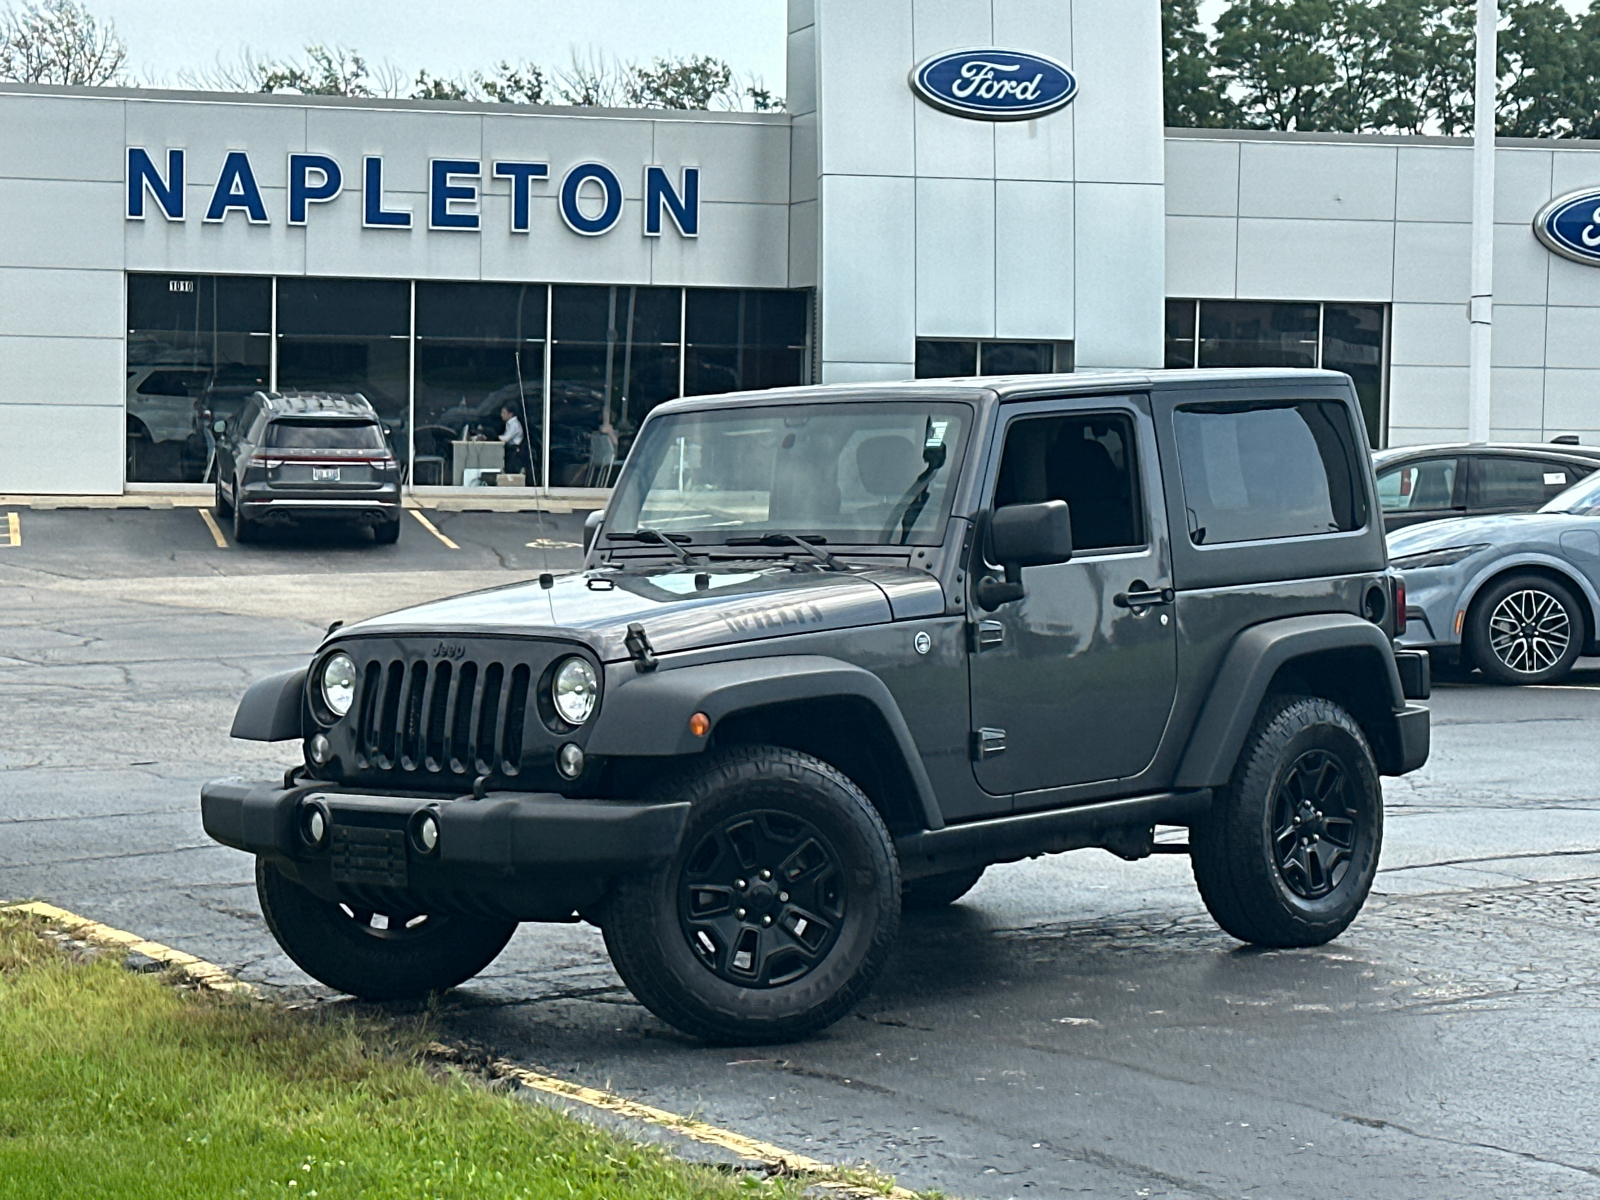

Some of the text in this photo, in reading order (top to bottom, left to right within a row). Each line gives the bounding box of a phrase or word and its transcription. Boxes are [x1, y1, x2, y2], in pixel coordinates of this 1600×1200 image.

[952, 61, 1043, 101] Ford
[125, 146, 701, 238] NAPLETON
[170, 281, 193, 292] 1010
[432, 641, 465, 661] Jeep
